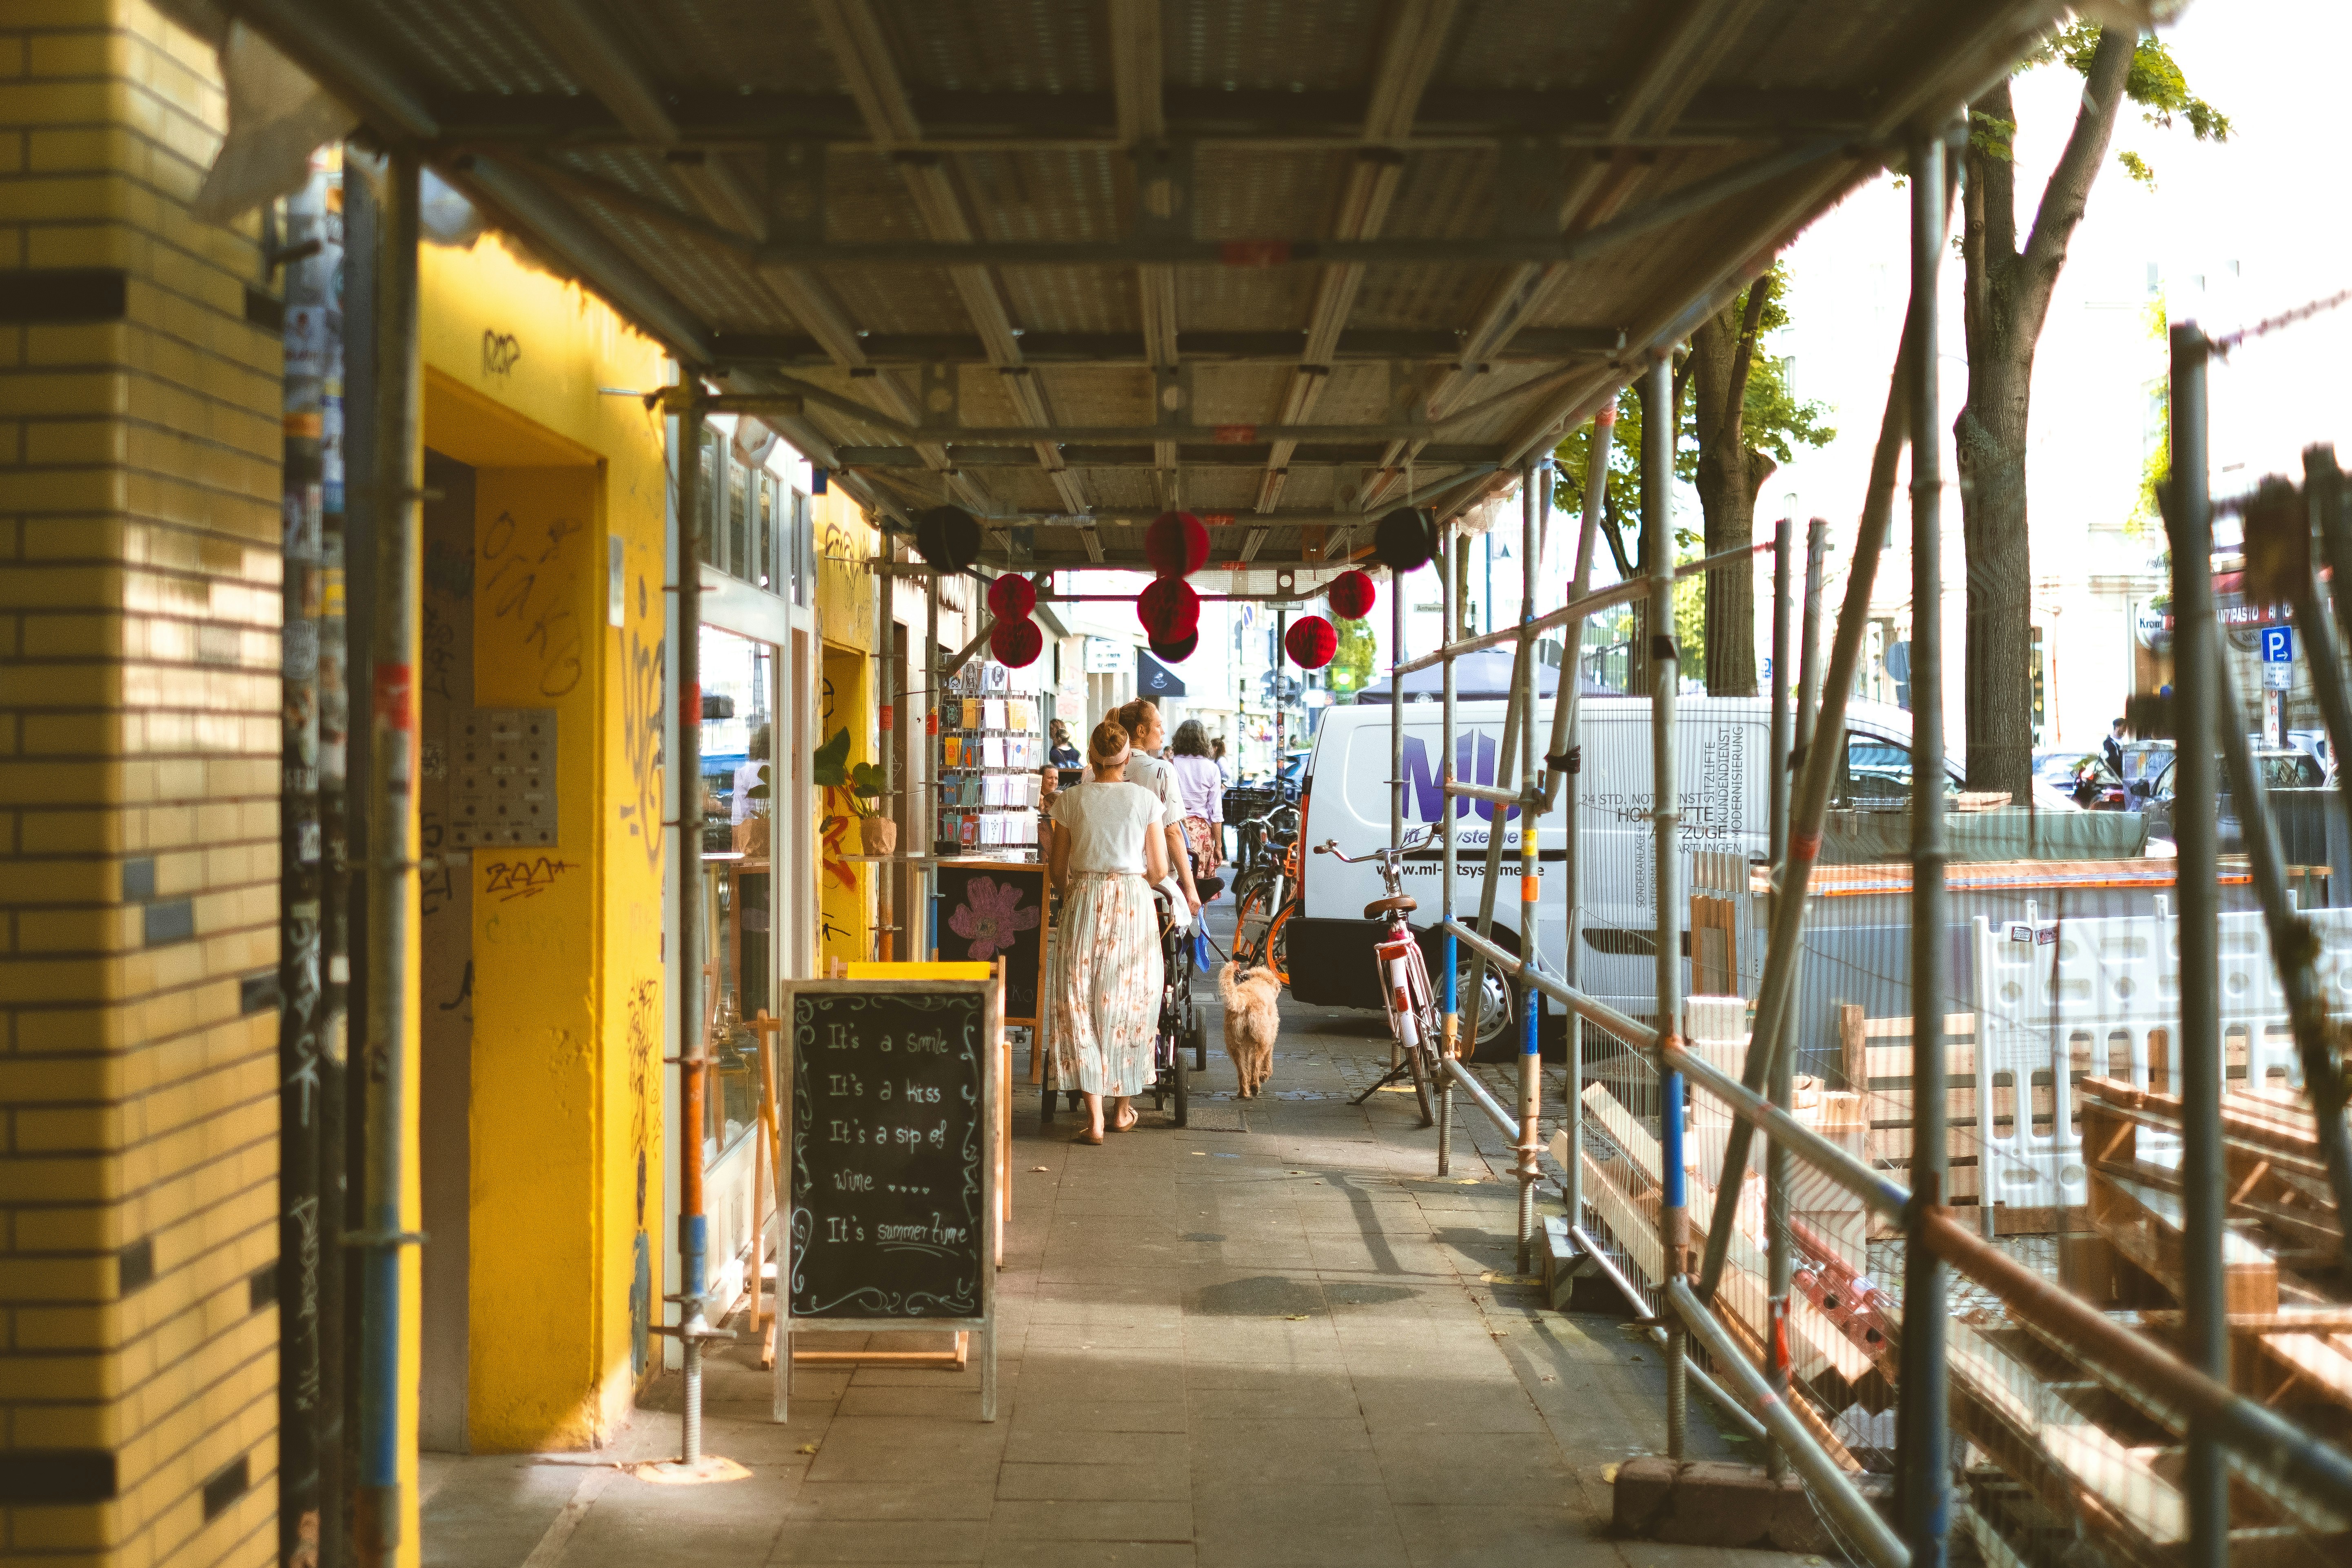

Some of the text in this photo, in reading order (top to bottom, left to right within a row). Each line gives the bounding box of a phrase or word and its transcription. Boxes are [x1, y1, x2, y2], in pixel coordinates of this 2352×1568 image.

[1704, 741, 1715, 803] SITZLIFTE
[1717, 727, 1729, 823] KUNDENDIENST
[1731, 727, 1743, 838] MODERNISIERUNG
[1632, 793, 1704, 805] NOTNST
[827, 1022, 859, 1049] It's
[880, 1034, 892, 1052] a
[828, 1073, 863, 1096] It's
[879, 1080, 892, 1100] a
[829, 1118, 947, 1154] It's a sip of
[826, 1215, 865, 1242] It's
